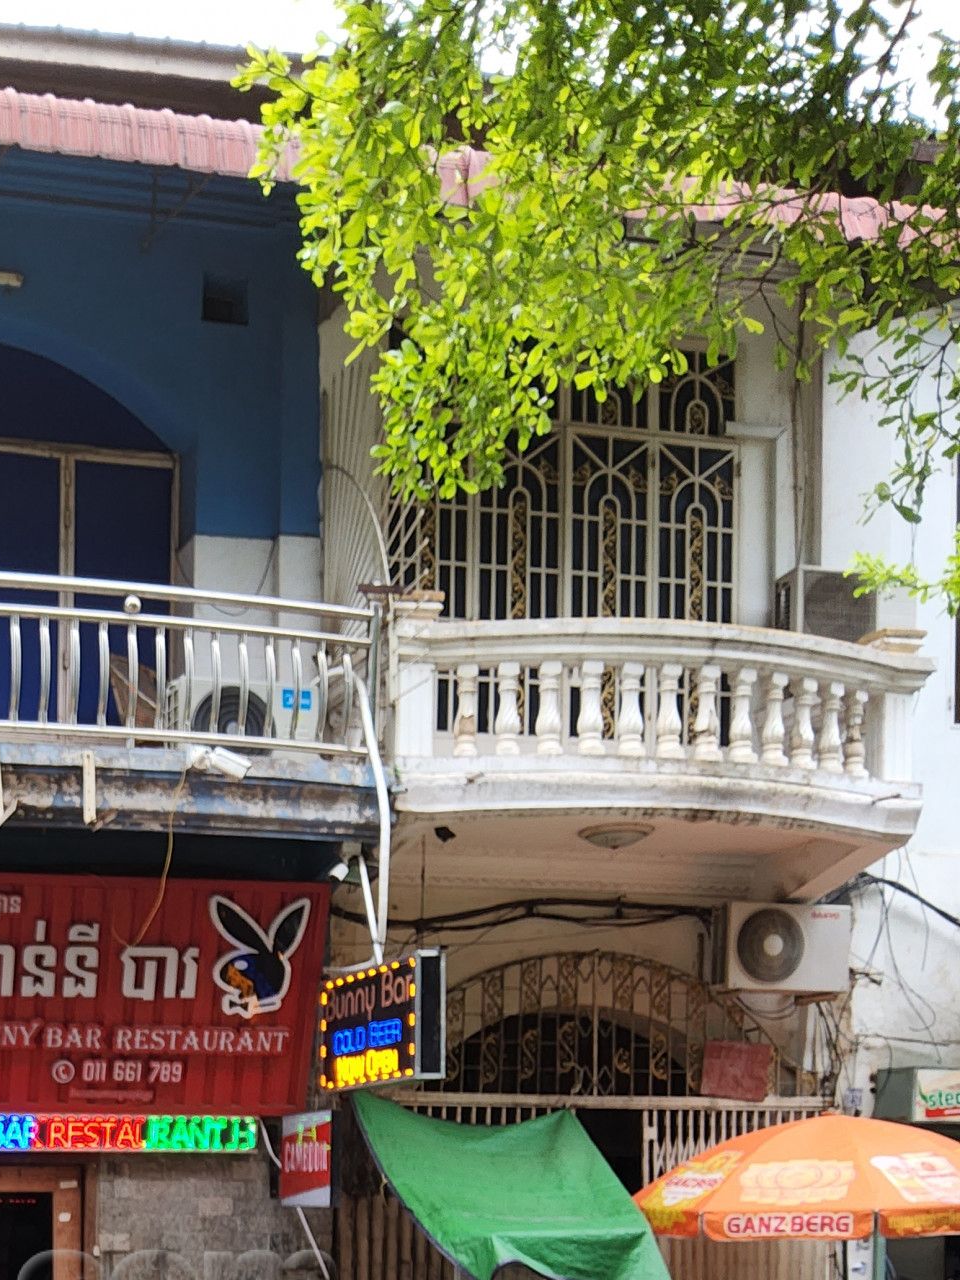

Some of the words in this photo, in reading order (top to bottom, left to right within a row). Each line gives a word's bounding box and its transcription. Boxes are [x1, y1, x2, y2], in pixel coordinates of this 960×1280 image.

[326, 983, 376, 1021] Bunny
[381, 971, 414, 1008] Bar
[46, 1025, 102, 1050] BAR
[115, 1027, 290, 1054] RESTAURANT
[82, 1060, 107, 1082] 011
[113, 1060, 142, 1083] 661
[148, 1061, 183, 1084] 789
